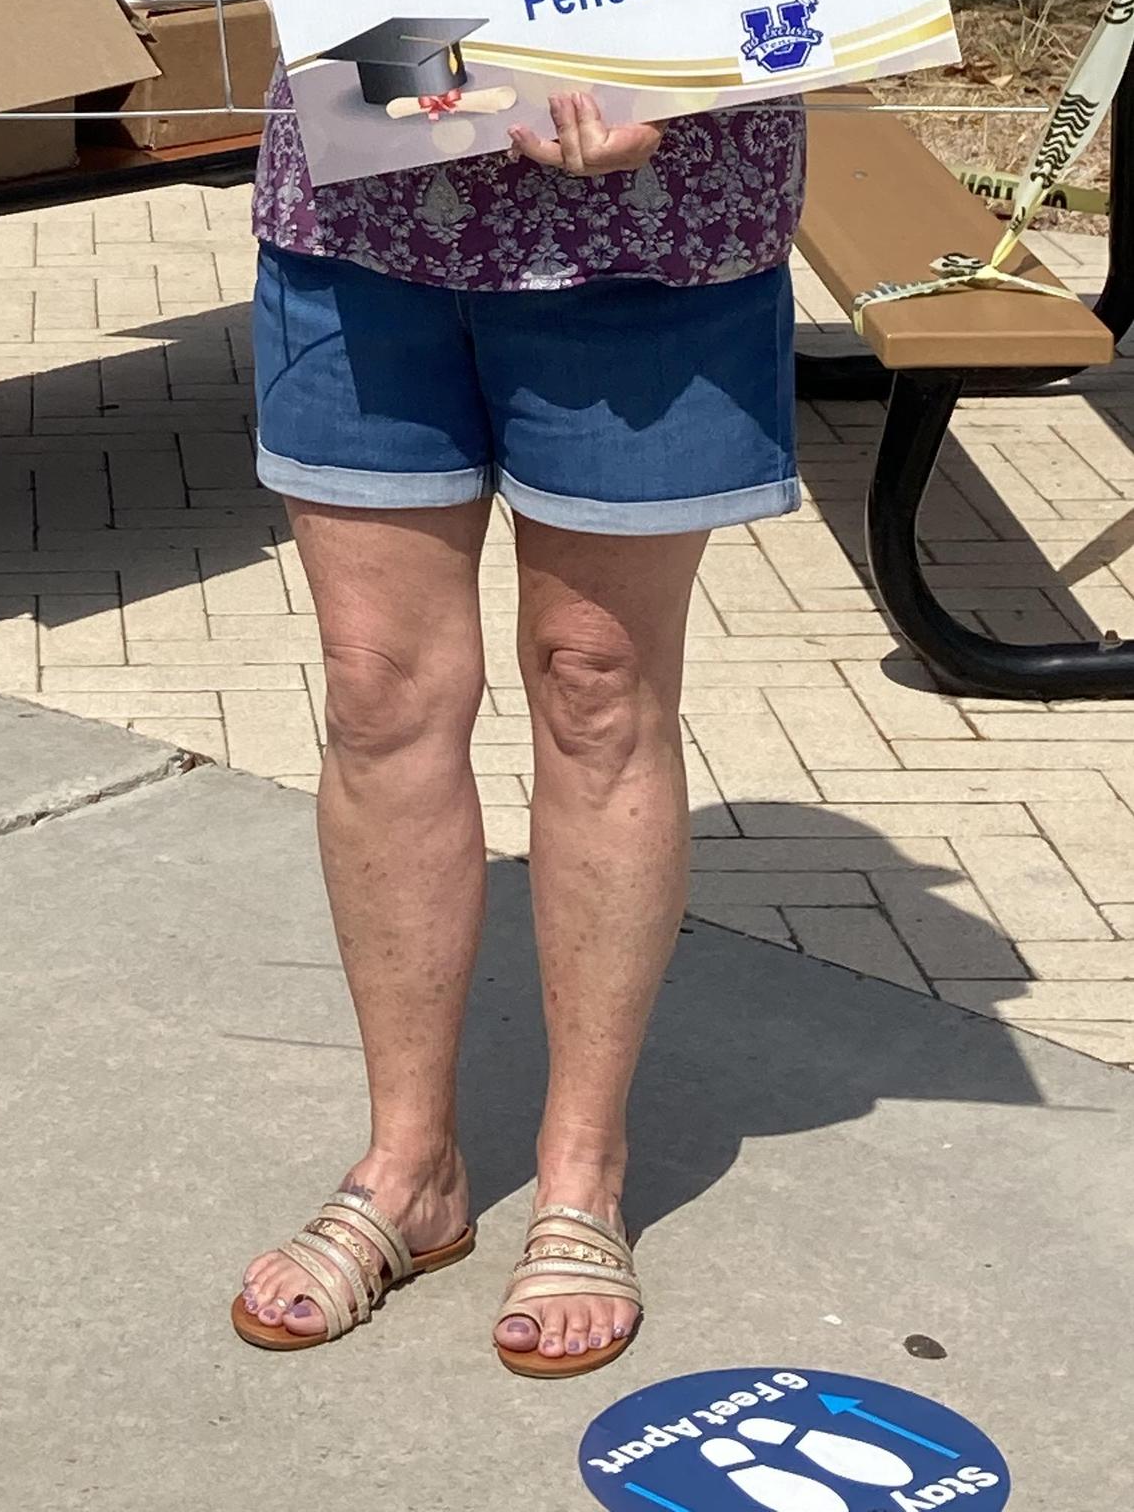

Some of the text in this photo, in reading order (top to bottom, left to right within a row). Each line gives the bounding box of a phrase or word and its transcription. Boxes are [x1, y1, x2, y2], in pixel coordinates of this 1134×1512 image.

[587, 1371, 808, 1474] 6 Feet Apart
[889, 1466, 999, 1512] Stay
